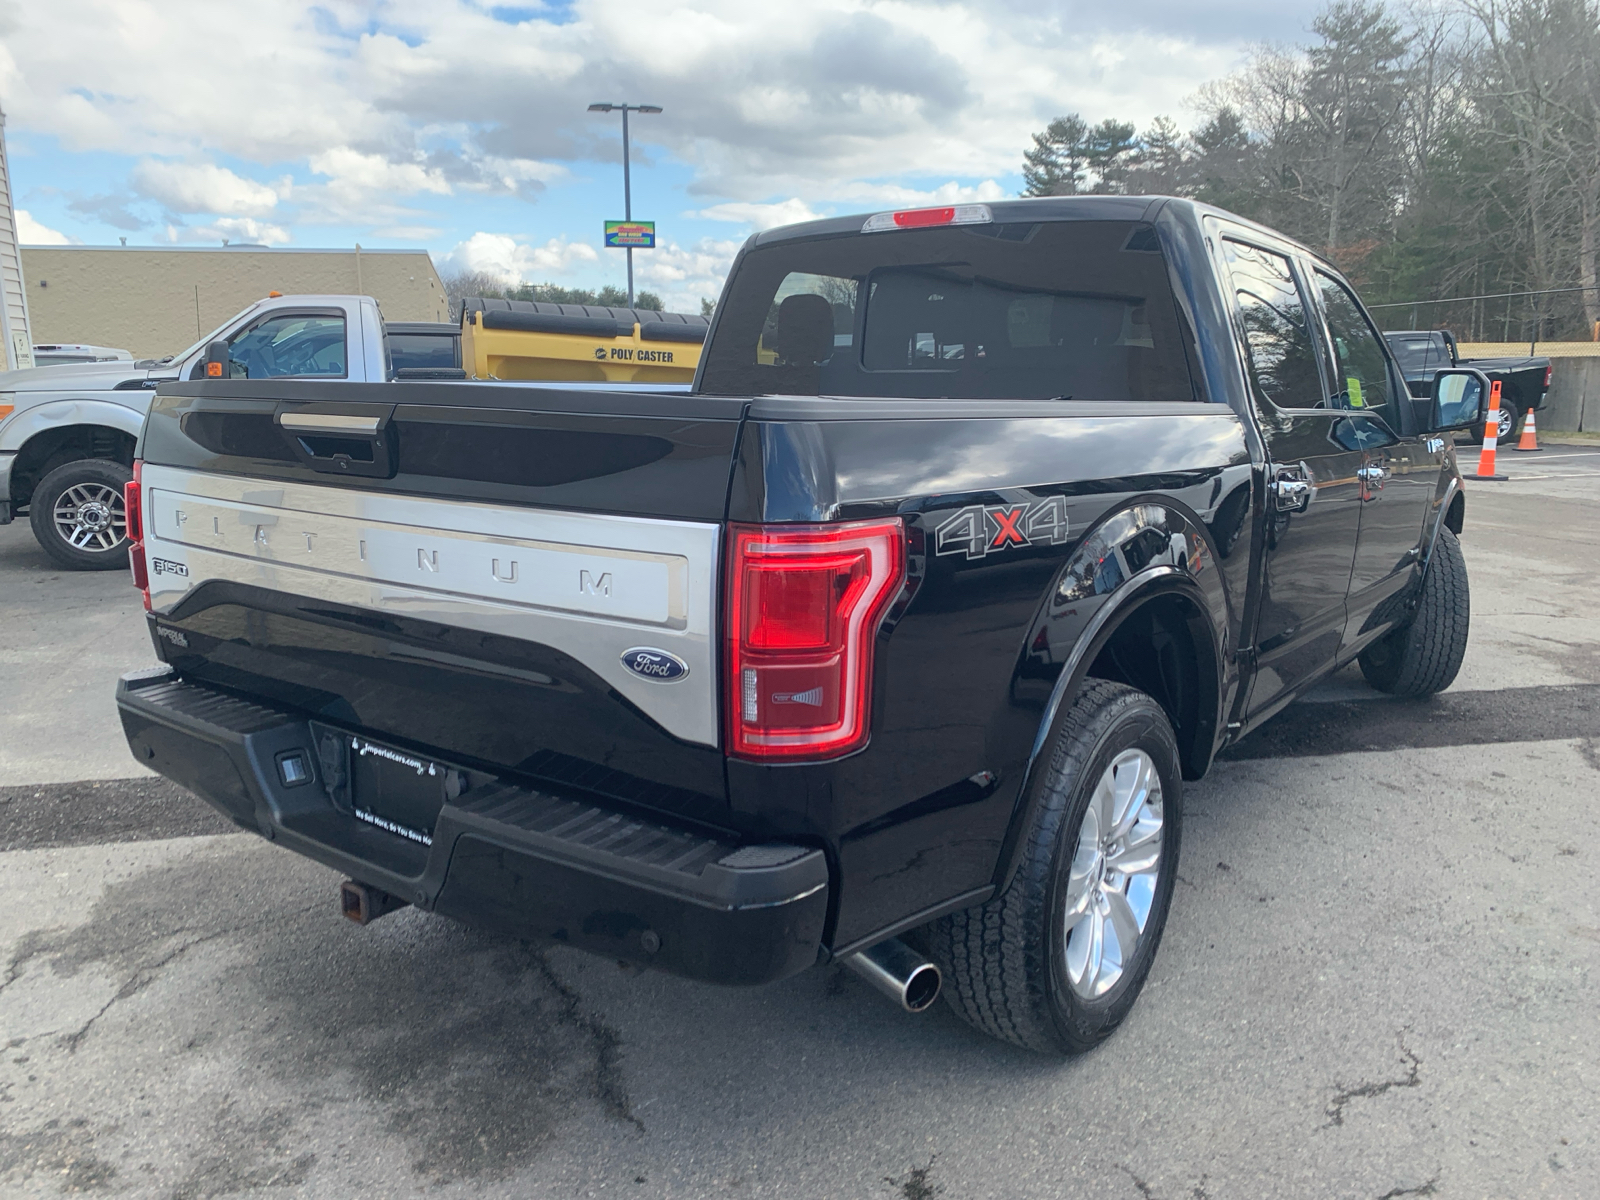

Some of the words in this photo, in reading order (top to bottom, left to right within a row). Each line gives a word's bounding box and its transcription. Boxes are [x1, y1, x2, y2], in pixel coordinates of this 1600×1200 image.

[610, 347, 634, 361] POLY
[637, 349, 674, 363] CASTER
[175, 509, 613, 598] PLATINUM
[633, 652, 670, 677] Ford
